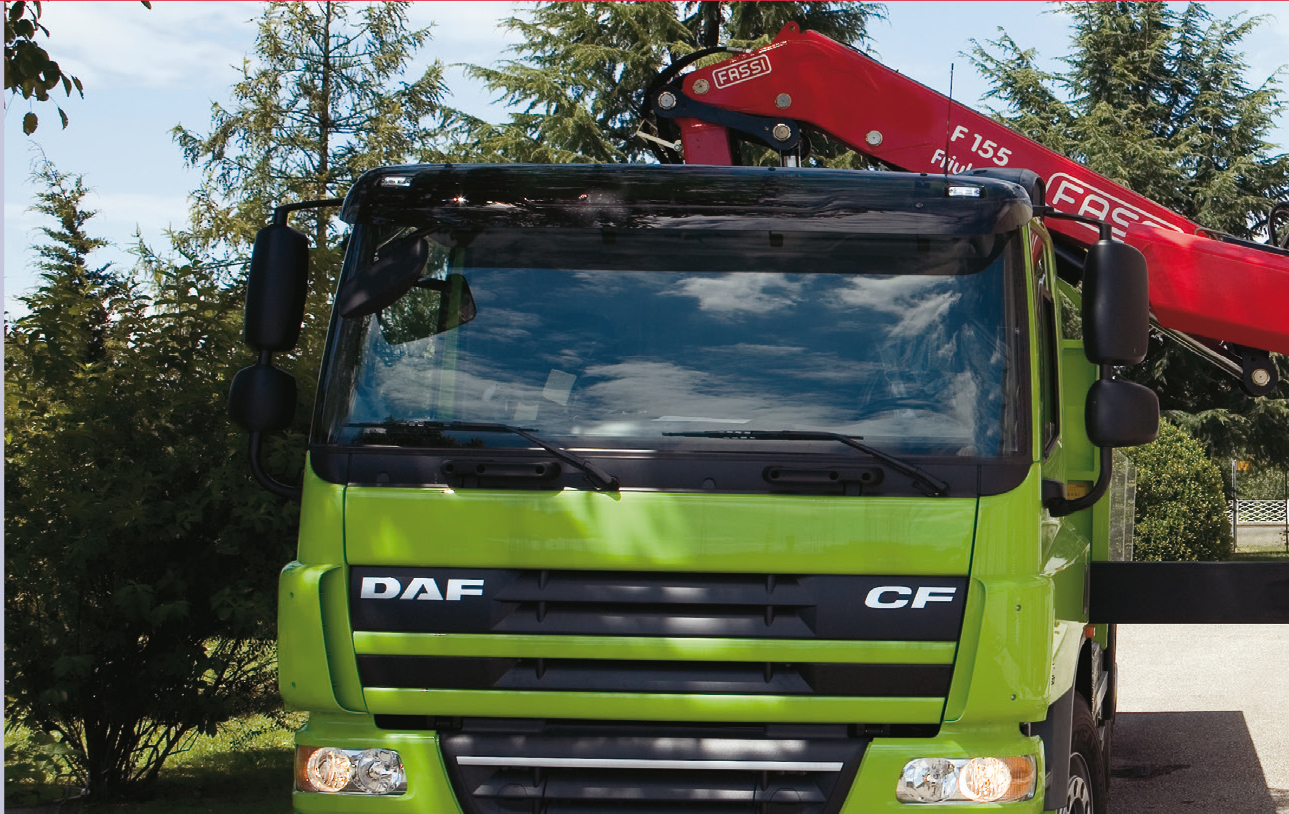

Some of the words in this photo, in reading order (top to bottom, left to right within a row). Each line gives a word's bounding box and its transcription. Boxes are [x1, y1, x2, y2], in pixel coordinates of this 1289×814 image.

[717, 59, 767, 85] FASSI
[950, 125, 969, 142] F
[970, 133, 1012, 166] 155
[1052, 180, 1162, 239] FAS
[360, 576, 485, 601] DAF
[864, 585, 957, 609] CF
